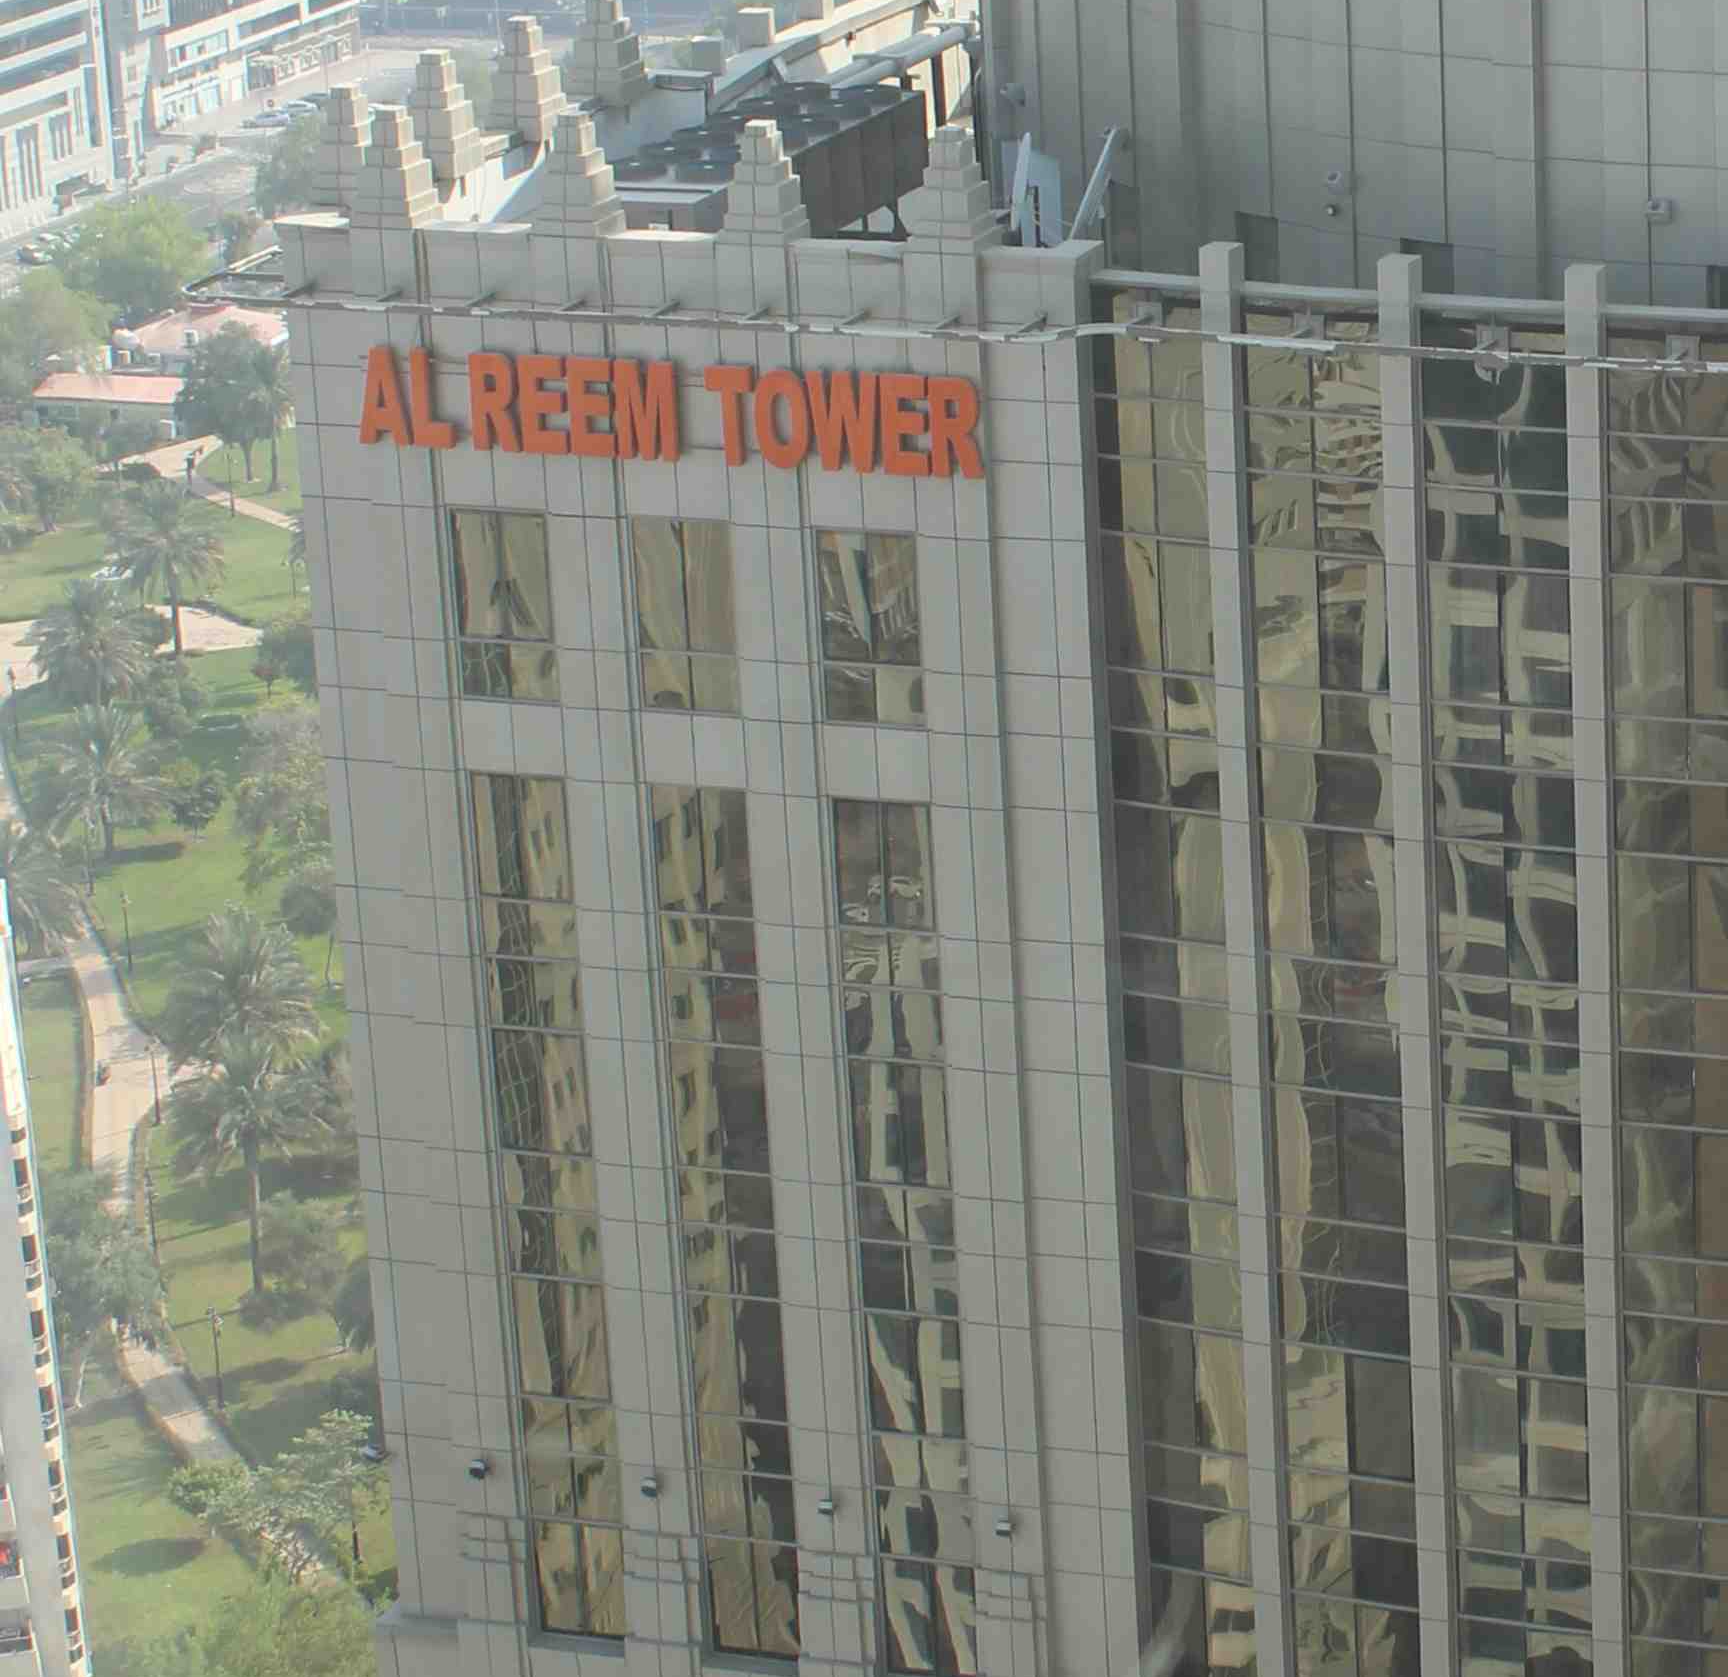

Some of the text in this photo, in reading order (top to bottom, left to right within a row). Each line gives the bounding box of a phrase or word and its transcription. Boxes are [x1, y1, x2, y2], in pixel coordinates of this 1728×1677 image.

[360, 345, 982, 478] AL REEM TOWER
